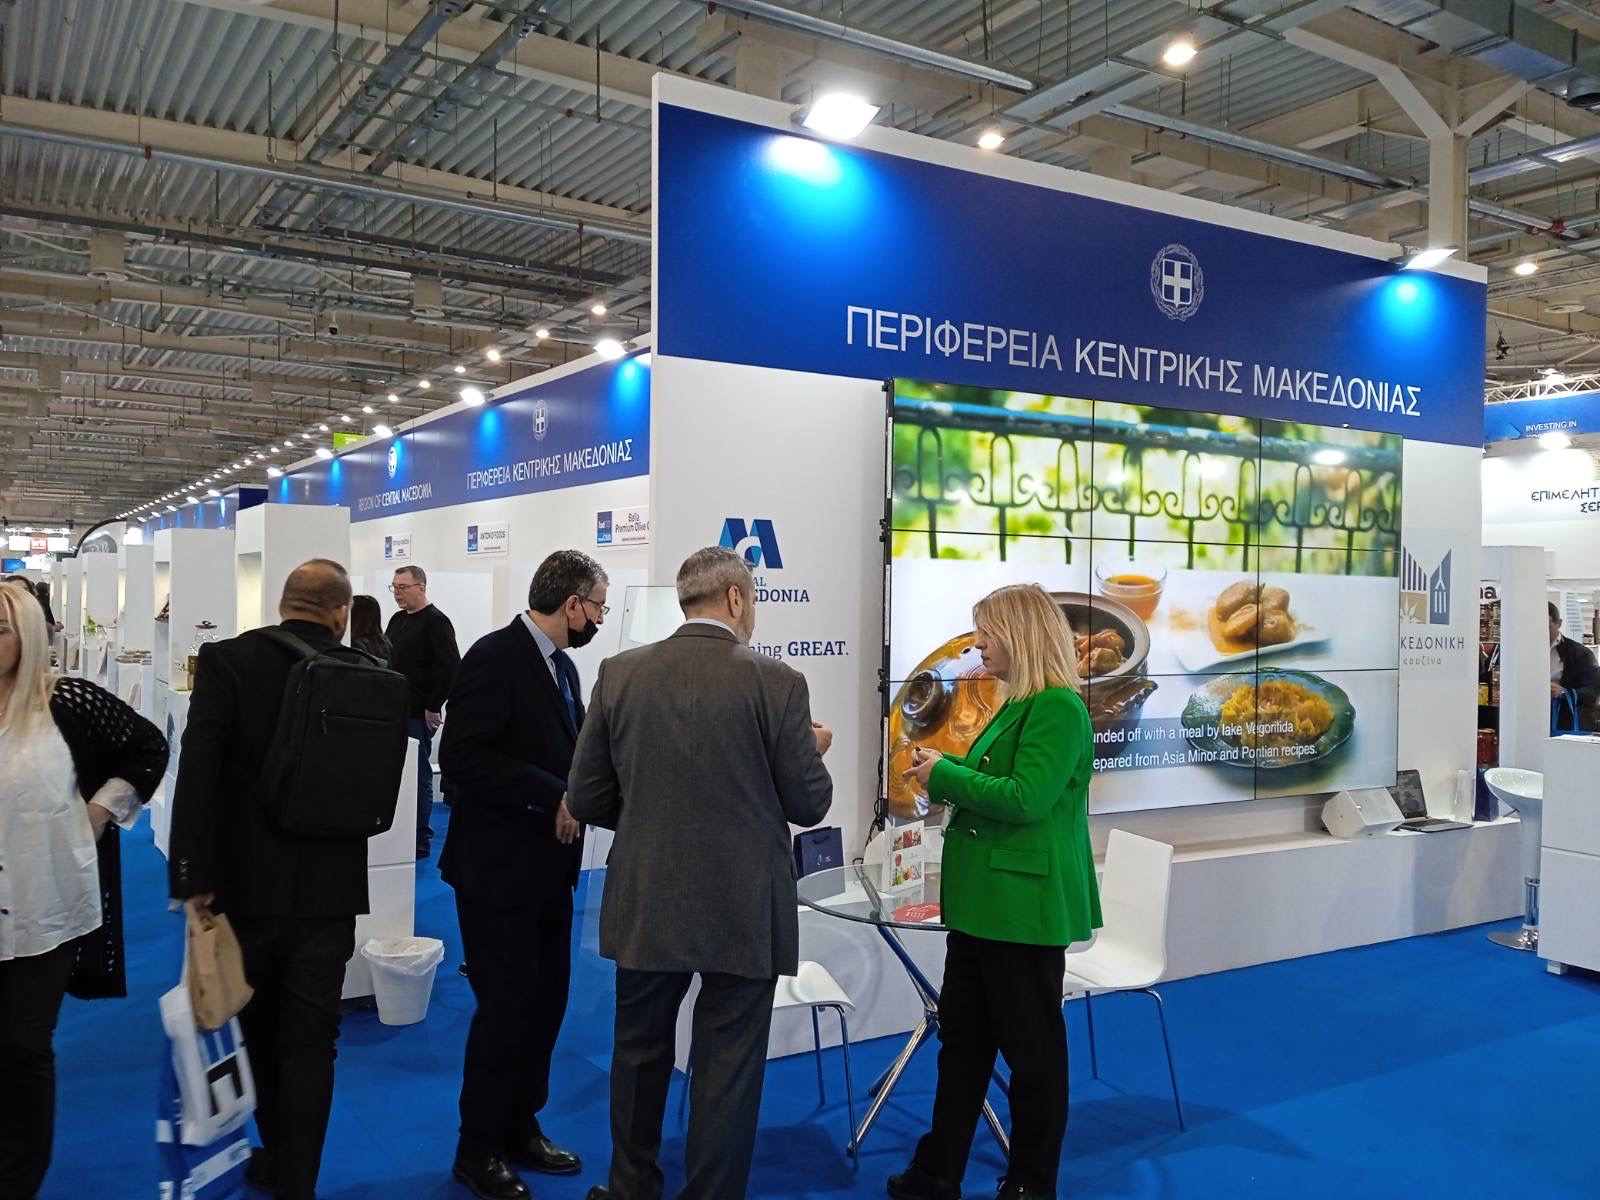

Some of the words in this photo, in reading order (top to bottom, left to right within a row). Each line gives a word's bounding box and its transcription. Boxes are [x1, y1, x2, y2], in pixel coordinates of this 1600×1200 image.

[847, 305, 1063, 371] ΠΕΡΙΦΕΡΕΙΑ
[1076, 338, 1244, 394] ΚΕΝΤΡΙΚΗΣ
[1253, 366, 1422, 417] ΜΑΚΕΔΟΝΙΑΣ
[1525, 421, 1567, 432] INVESTING
[1569, 420, 1577, 428] IN
[467, 465, 511, 490] ΠΕΡΙΦΕΡΕΙΑ
[512, 454, 561, 482] ΚΕΝΤΡΙΚΗΣ
[563, 438, 633, 473] ΜΑΚΕΔΟΝΙΑΣ
[375, 493, 382, 508] OF
[382, 488, 401, 507] CENTRAL
[402, 482, 432, 503] MACEDONIA
[1531, 487, 1600, 502] ΕΠΙΜΕΛΗΤ
[615, 523, 634, 533] Premium
[634, 521, 646, 532] Olive
[787, 640, 849, 657] GREAT.
[1400, 636, 1465, 650] ΚΕΔΟΝΙΚΗ
[1128, 727, 1142, 742] off
[1144, 726, 1166, 741] with
[1168, 730, 1176, 739] a
[1179, 725, 1205, 739] meal
[1207, 723, 1220, 740] by
[1222, 722, 1243, 736] lake
[1245, 720, 1294, 737] Vegoritida
[1093, 753, 1132, 773] epared
[1135, 752, 1160, 766] from
[1162, 750, 1185, 764] Asia
[1188, 748, 1217, 763] Minor
[1219, 745, 1239, 760] and
[1241, 745, 1279, 759] Pontian
[1281, 742, 1317, 759] recipes.
